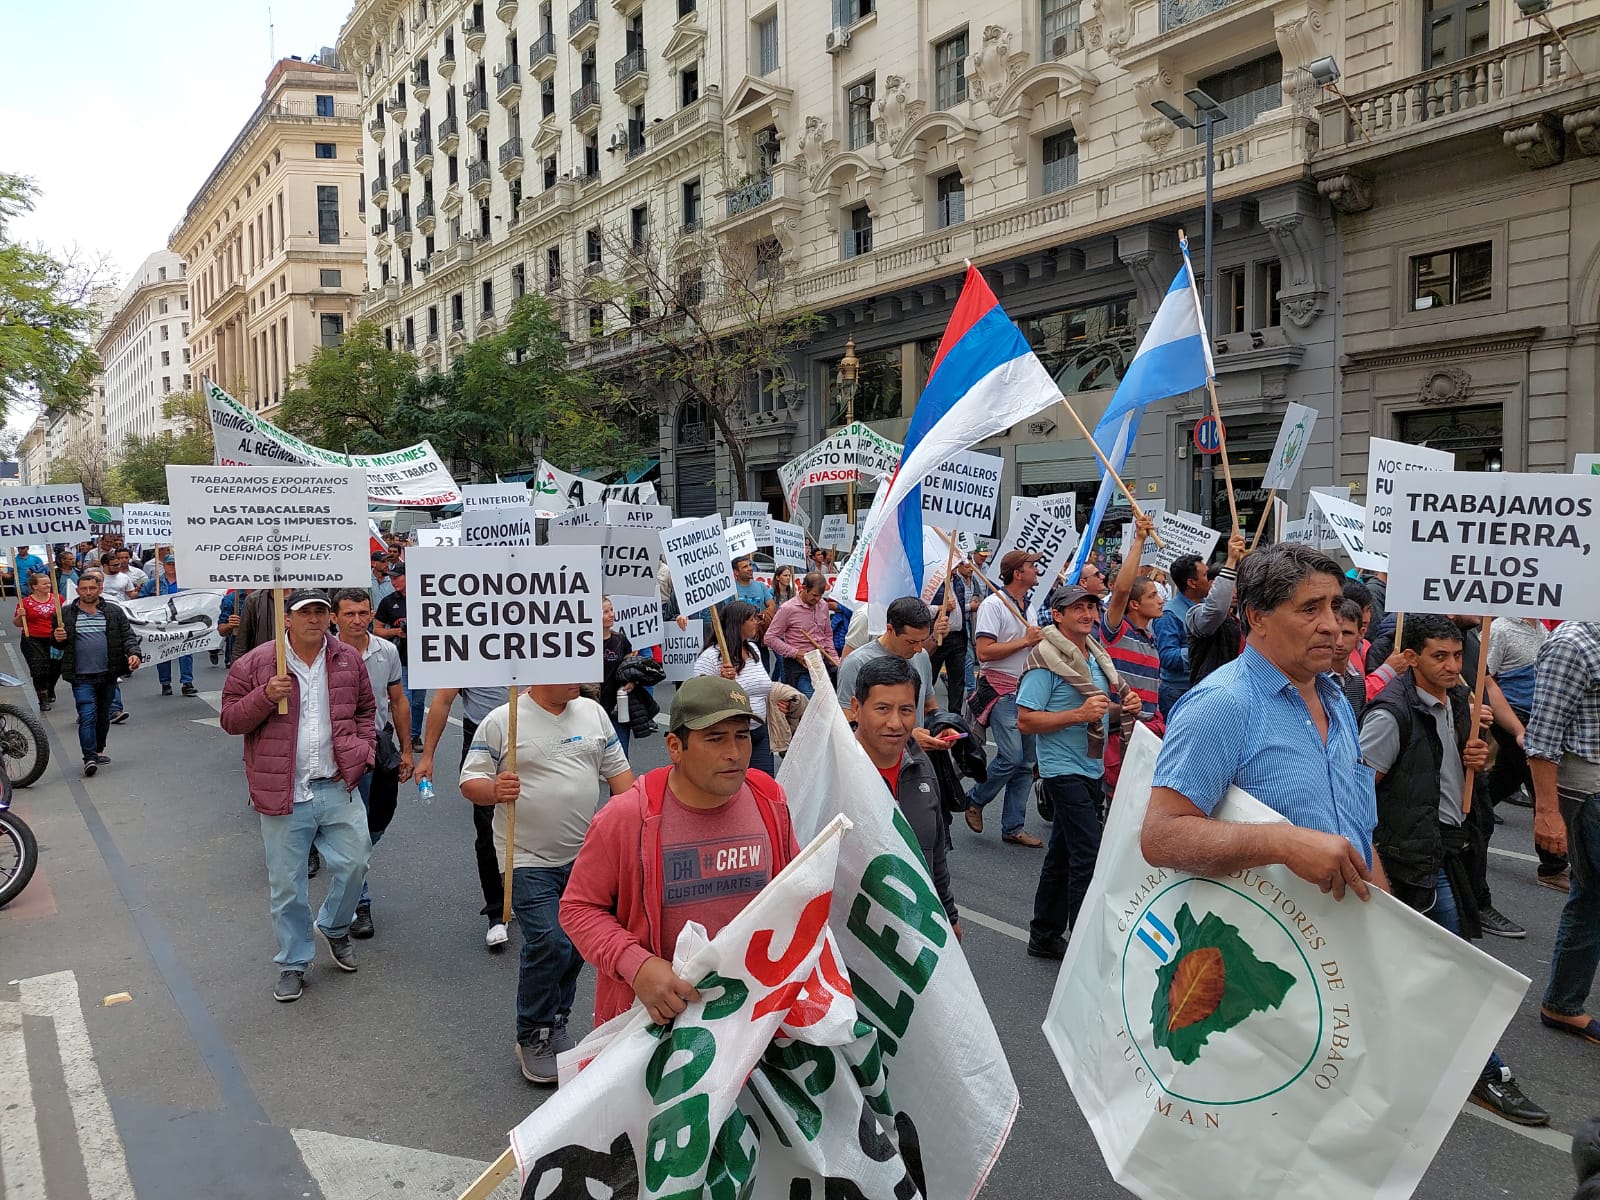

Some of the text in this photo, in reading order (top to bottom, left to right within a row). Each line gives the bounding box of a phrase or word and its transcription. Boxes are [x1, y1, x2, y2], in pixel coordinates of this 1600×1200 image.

[238, 438, 252, 453] AL
[836, 438, 851, 450] LA
[354, 458, 371, 468] DE
[371, 446, 427, 468] MISIONES
[190, 475, 349, 485] TRABAJAMOS EXPORTAMOS
[385, 473, 401, 482] DEL
[401, 461, 438, 480] TABACO
[205, 484, 335, 494] GENERAMOS DÓLARES.
[924, 474, 995, 499] DE MISIONES
[0, 494, 80, 507] ABACALEROS
[213, 505, 331, 514] LAS TABACALERAS
[465, 494, 526, 506] EL INTERIOR
[922, 494, 944, 512] EN
[945, 498, 992, 521] LUCHA
[1406, 493, 1593, 517] TRABAJAMOS
[18, 506, 82, 519] MISIONES
[187, 517, 357, 526] NO PAGAN LOS IMPUESTOS.
[627, 511, 653, 522] AFIP
[1374, 505, 1393, 517] POR
[0, 519, 87, 537] EN LUCHA
[129, 527, 144, 536] EN
[466, 518, 531, 541] ECONOMÍA
[1372, 520, 1392, 534] LOS
[1411, 519, 1592, 556] LA TIERRA,
[195, 542, 353, 552] AFIP COBRÁ LOS IMPUESTOS
[237, 535, 264, 543] AFIP
[666, 525, 721, 552] ESTAMPILLAS
[219, 552, 332, 561] DEFINIDOS POR LEY.
[676, 542, 722, 567] TRUCHAS,
[776, 547, 785, 556] EN
[1034, 525, 1067, 577] CRISIS
[601, 563, 654, 579] UPTA
[684, 561, 725, 587] NEGOCIO
[1450, 554, 1539, 578] ELLOS
[209, 573, 343, 582] BASTA DE IMPUNIDAD
[420, 565, 590, 597] ECONOMÍA
[684, 575, 731, 606] REDONDO
[1423, 578, 1563, 607] EVADEN
[421, 600, 593, 628] REGIONAL
[629, 615, 659, 638] LEY!
[148, 632, 185, 643] CAMARA
[421, 631, 596, 662] EN CRISIS
[664, 636, 700, 652] JUSTICIA
[703, 844, 761, 872] #CREW
[667, 876, 751, 900] CUSTOM PARTS
[1117, 871, 1167, 933] CAMARA
[1320, 960, 1345, 992] DE
[1314, 1003, 1351, 1090] TABACO
[1115, 1025, 1220, 1129] TUCUMAN
